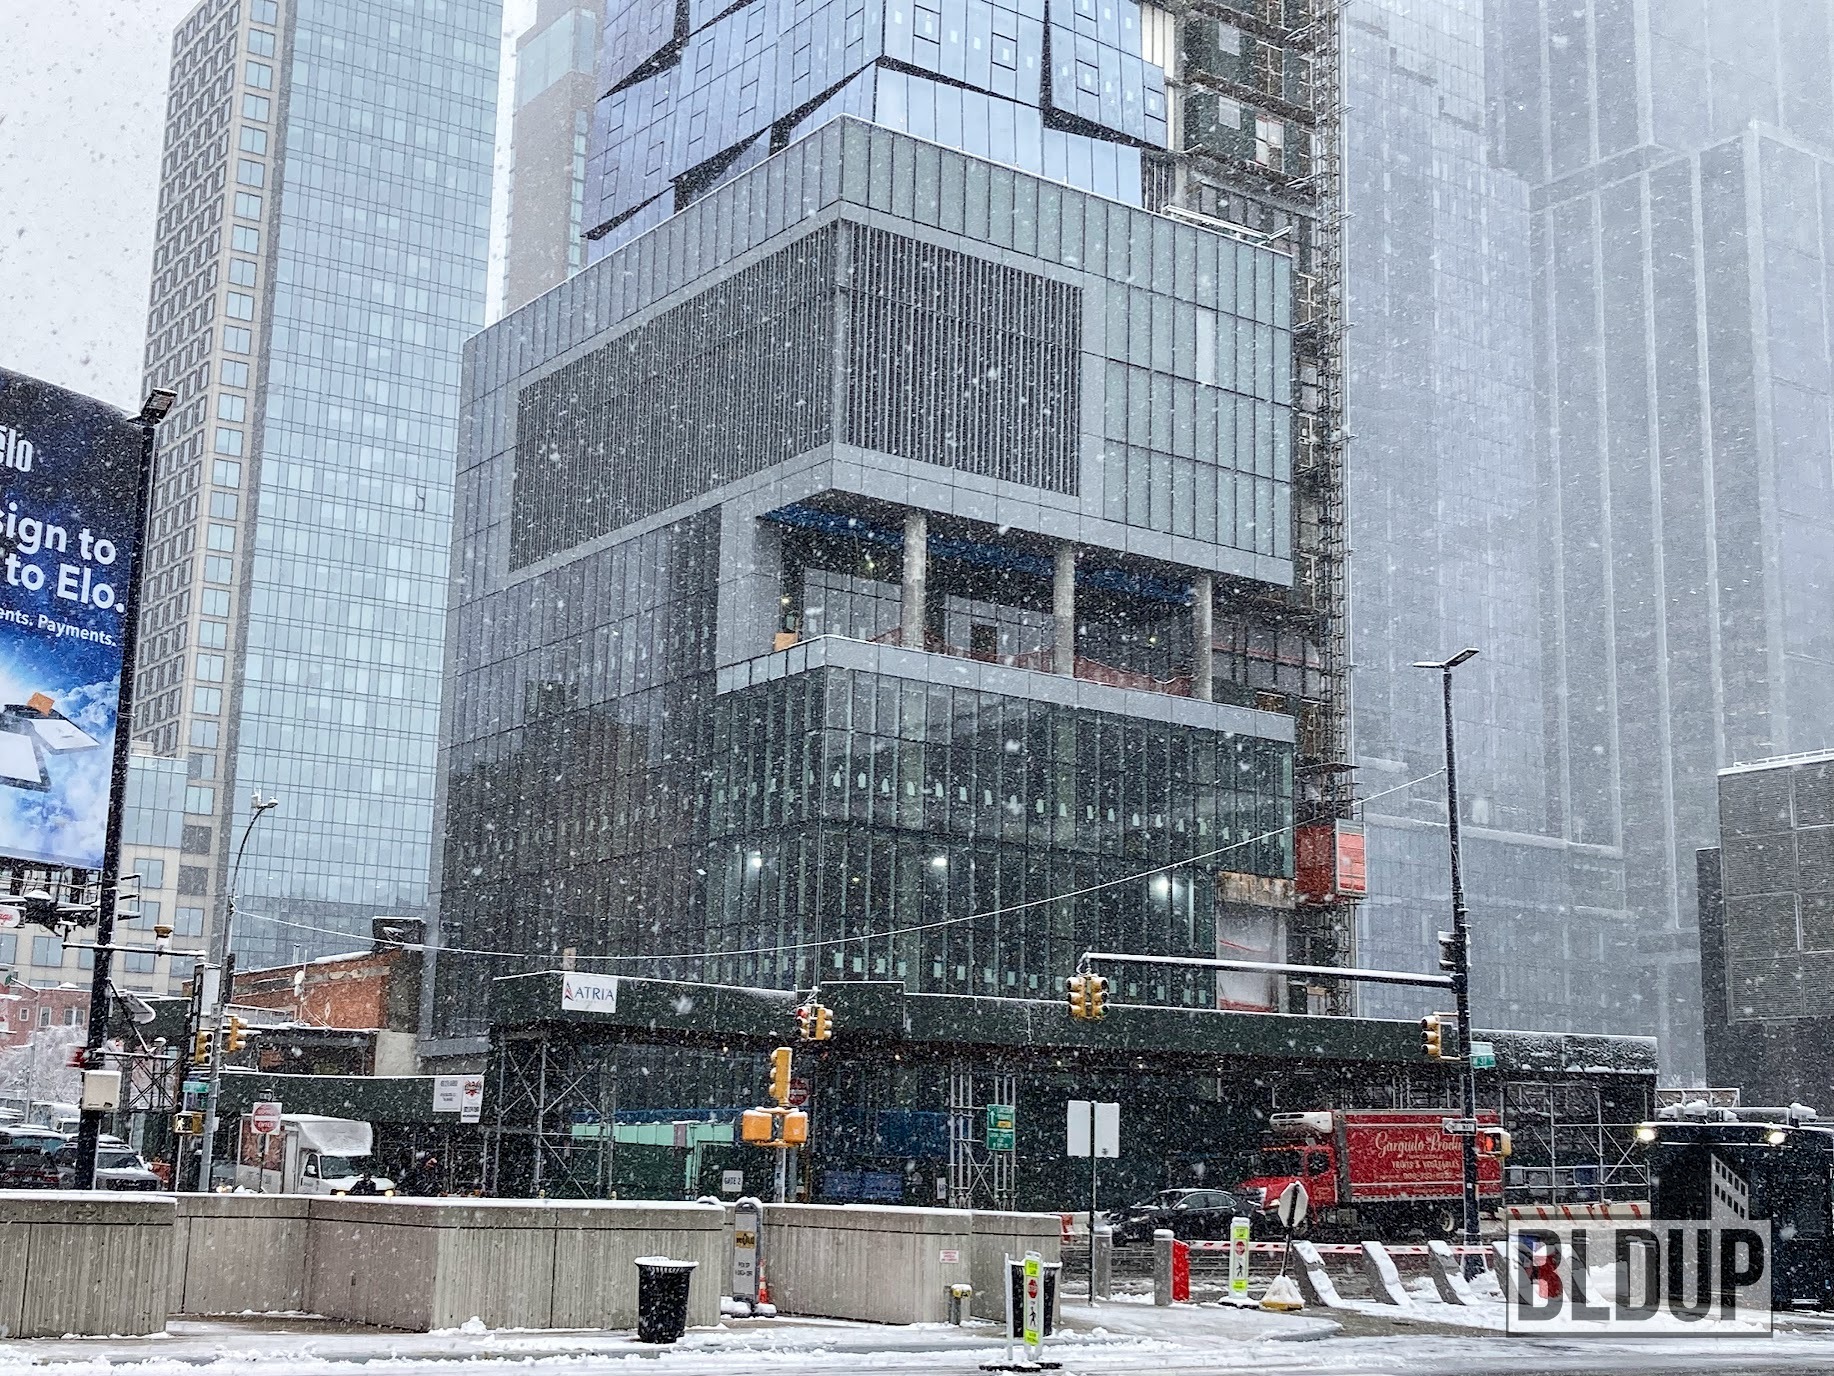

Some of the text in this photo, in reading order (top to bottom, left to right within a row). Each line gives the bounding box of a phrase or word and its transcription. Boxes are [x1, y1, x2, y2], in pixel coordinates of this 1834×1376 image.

[0, 502, 117, 565] ign to
[5, 552, 124, 613] to Elo.
[37, 613, 117, 647] Payments.
[574, 986, 615, 1002] ATRIA
